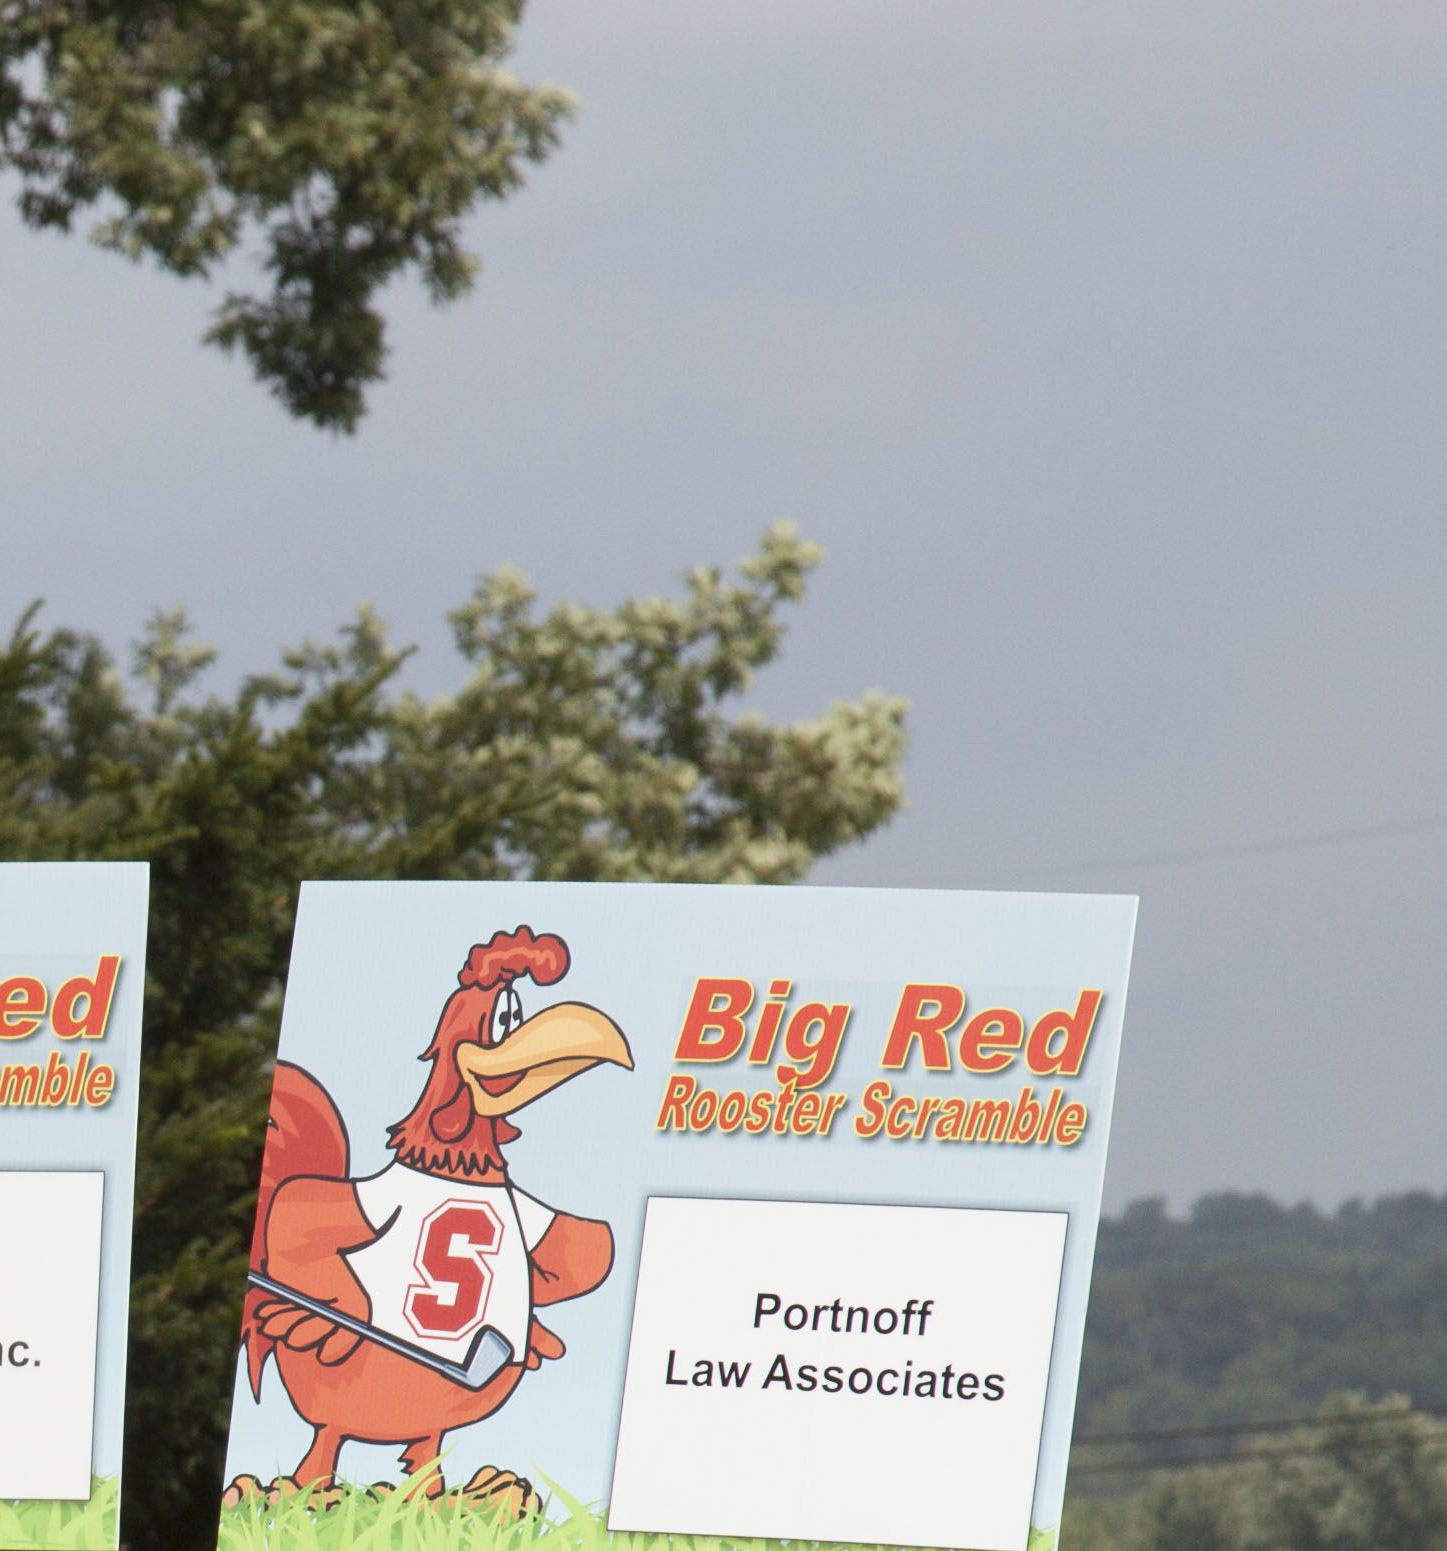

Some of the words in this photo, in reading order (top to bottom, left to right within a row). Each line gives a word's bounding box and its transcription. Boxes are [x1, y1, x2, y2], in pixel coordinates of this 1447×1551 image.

[674, 978, 849, 1088] Big
[881, 984, 1101, 1075] Red
[657, 1074, 845, 1134] Rooster
[855, 1081, 1085, 1144] Scramble
[402, 1198, 504, 1340] S
[754, 1293, 934, 1335] Portnoff
[666, 1350, 751, 1387] Law
[762, 1355, 1004, 1401] Associates
